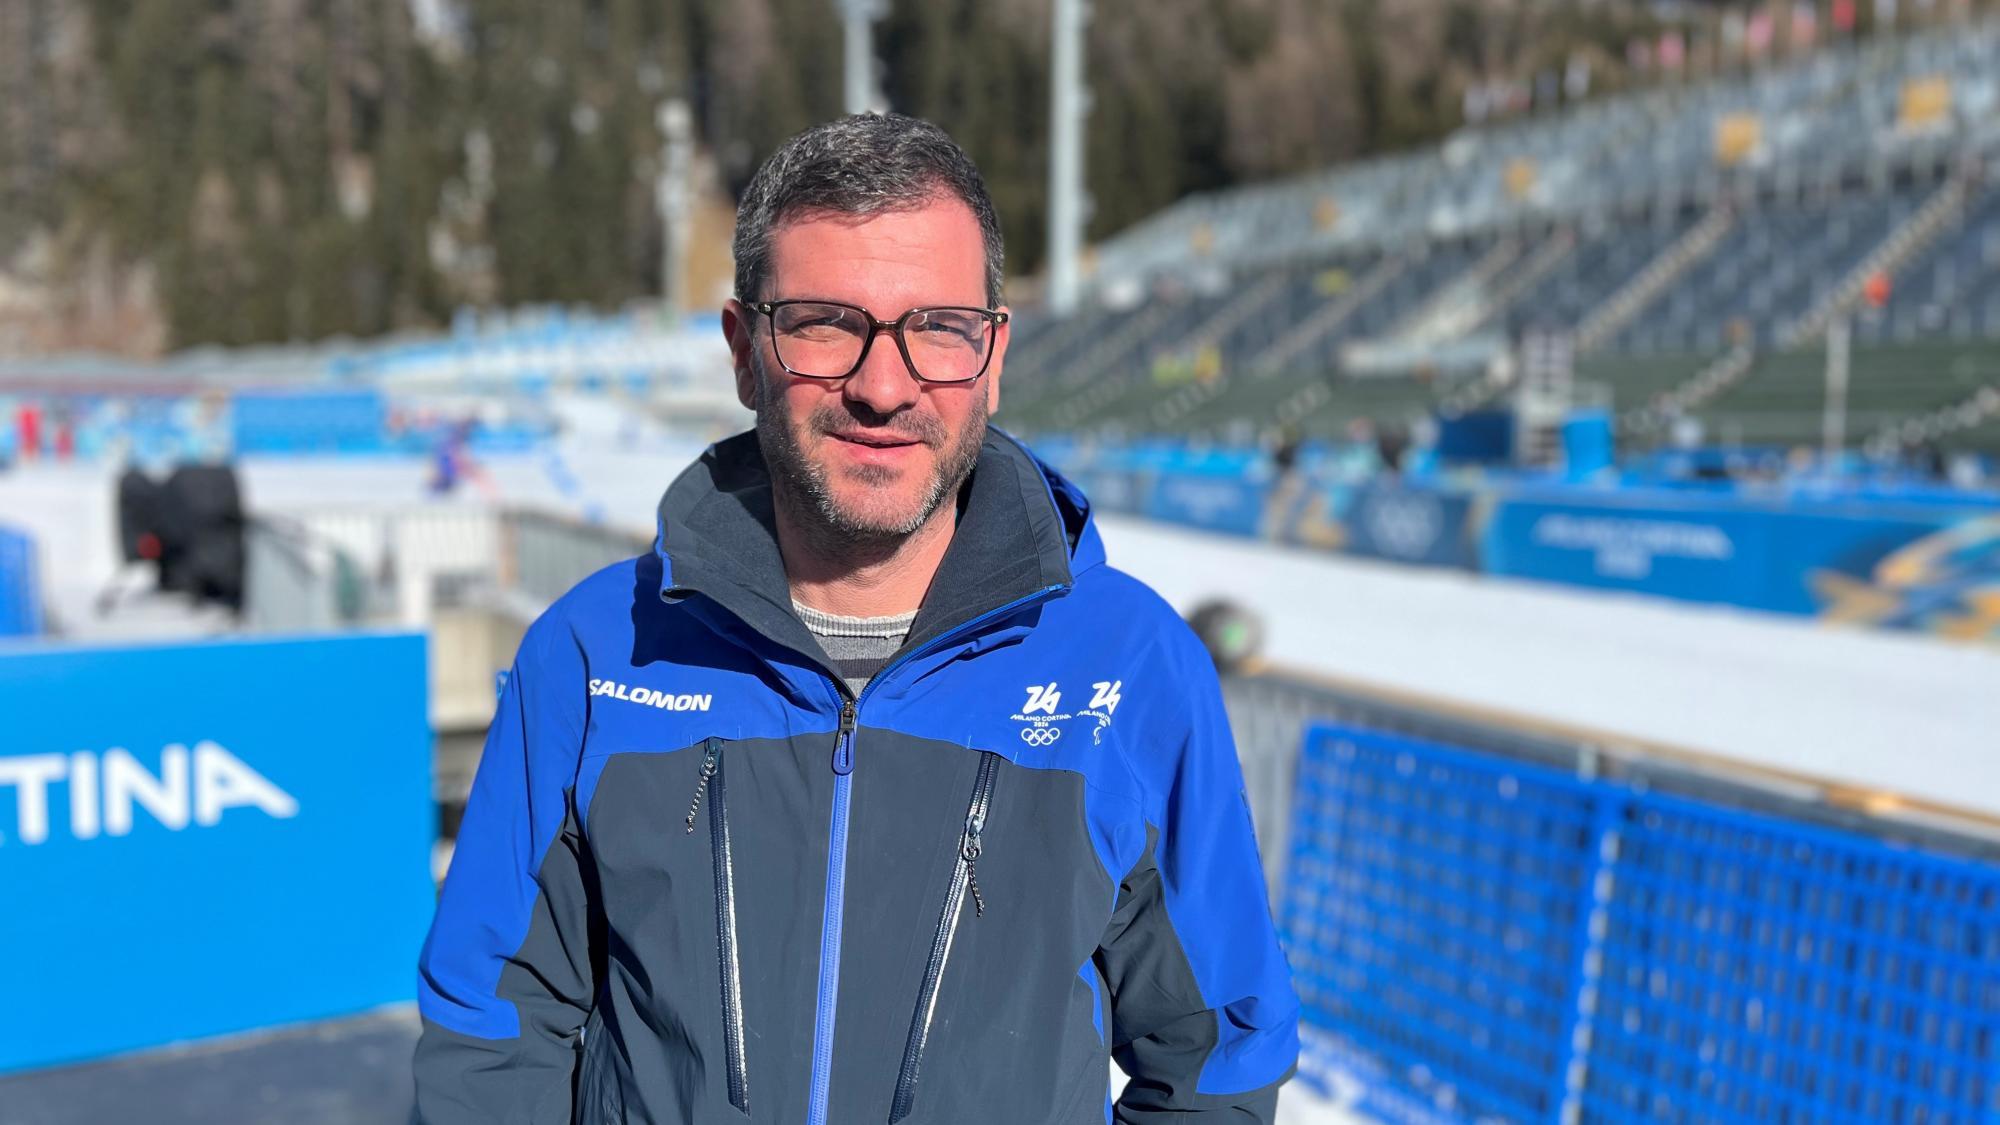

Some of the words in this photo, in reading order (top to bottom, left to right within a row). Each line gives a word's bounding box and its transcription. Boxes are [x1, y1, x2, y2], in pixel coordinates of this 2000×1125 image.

[589, 679, 712, 711] SALOMON
[1010, 714, 1041, 722] MILANO
[1042, 714, 1072, 722] CORTINA
[1076, 710, 1105, 719] MILANO
[0, 739, 299, 846] TINA
